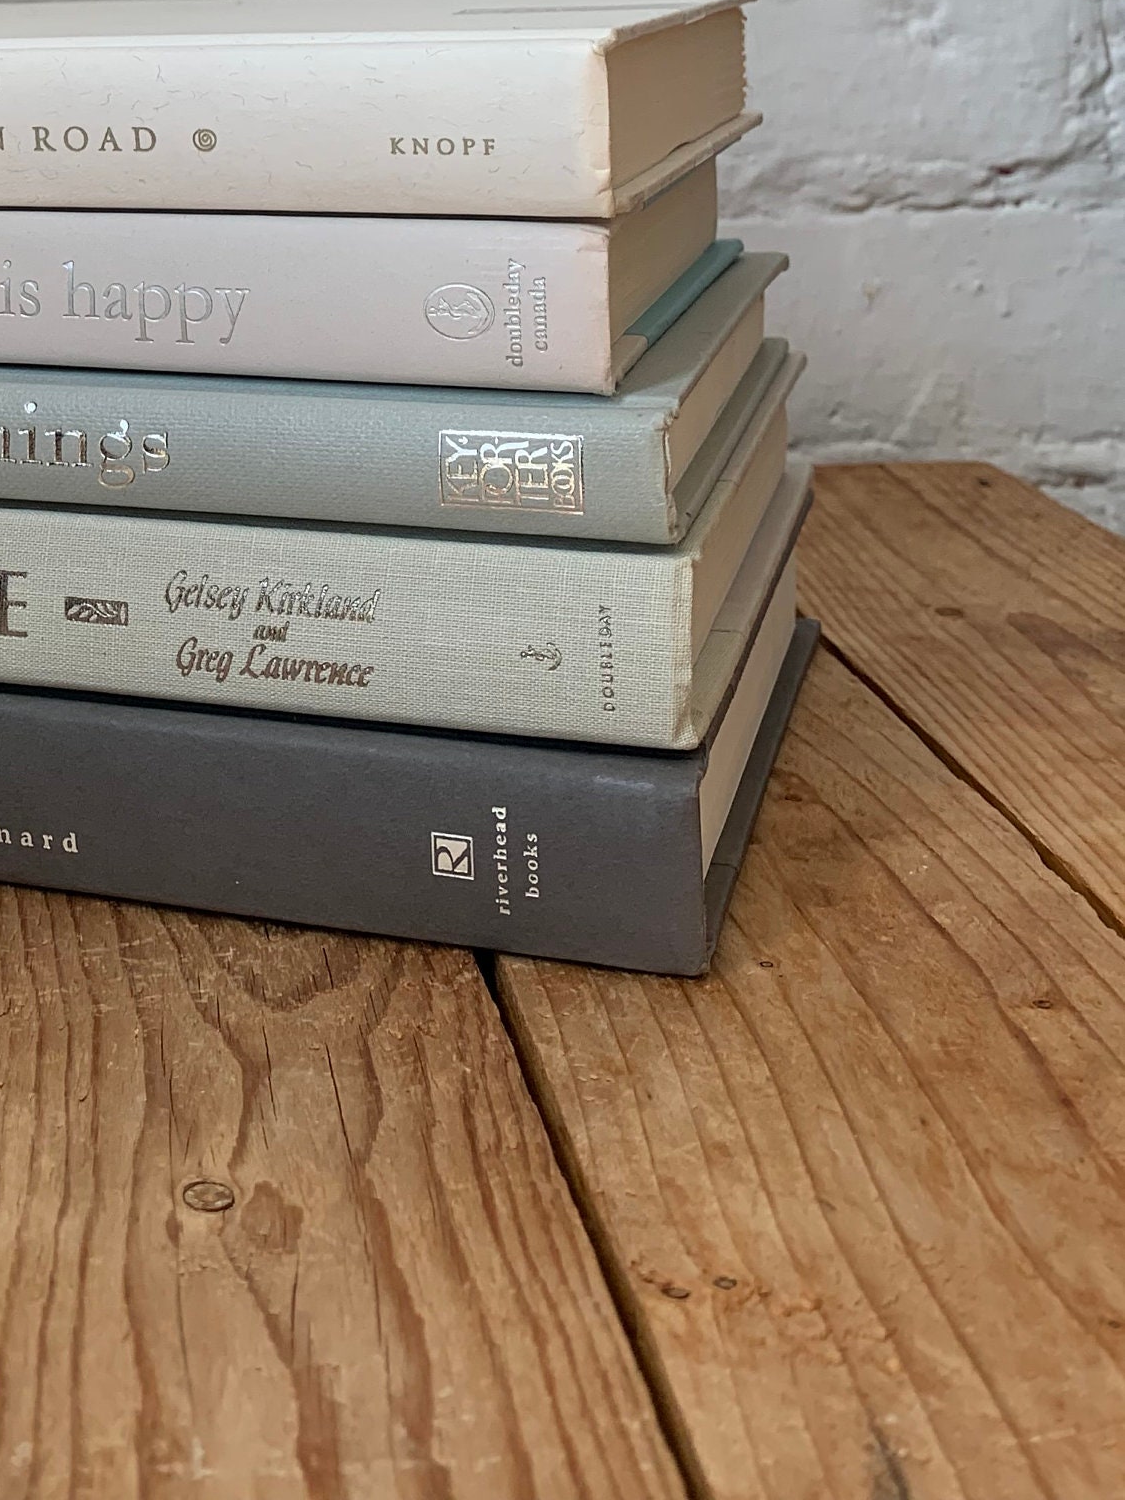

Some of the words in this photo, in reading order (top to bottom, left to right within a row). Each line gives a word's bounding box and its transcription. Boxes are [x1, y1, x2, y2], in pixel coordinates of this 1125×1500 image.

[33, 126, 158, 153] ROAD
[389, 137, 498, 157] KNOPF
[62, 261, 251, 346] happy
[503, 258, 526, 368] doubleday
[529, 276, 548, 353] canada
[445, 436, 479, 502] KEY
[514, 446, 549, 505] TER
[550, 440, 576, 509] BOOKS
[165, 569, 250, 622] Gelsey
[254, 576, 382, 624] Kirkland
[175, 636, 234, 683] Greg
[239, 643, 375, 688] Lawrence
[251, 620, 291, 643] and
[598, 604, 616, 712] DOUBLEDAY
[491, 806, 511, 916] riverhead
[523, 833, 540, 899] books
